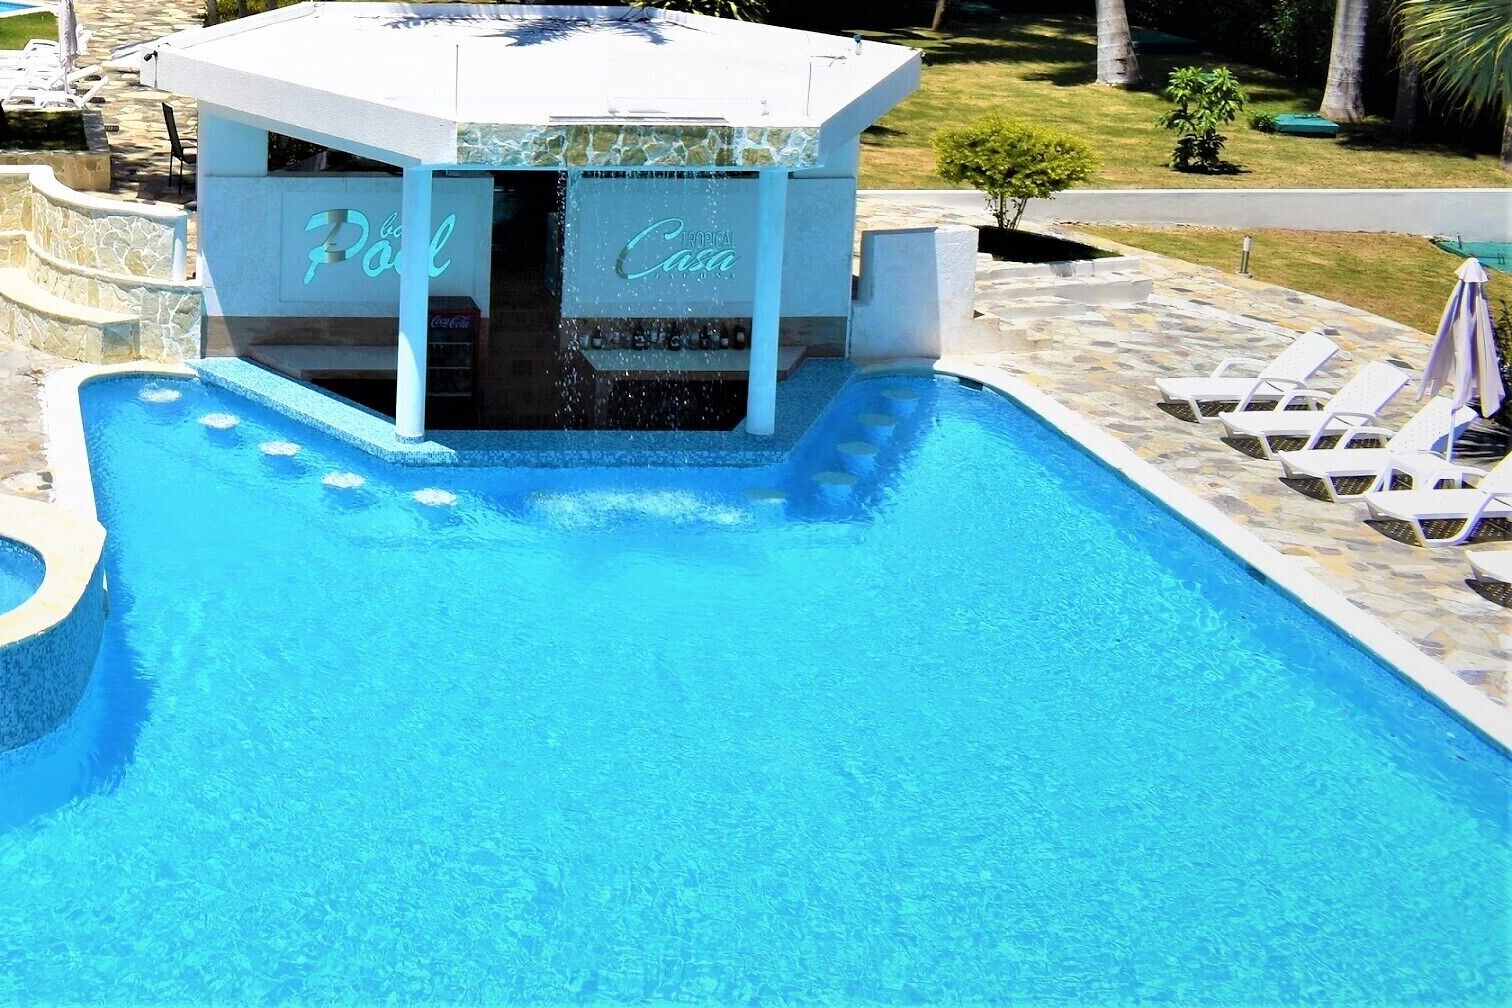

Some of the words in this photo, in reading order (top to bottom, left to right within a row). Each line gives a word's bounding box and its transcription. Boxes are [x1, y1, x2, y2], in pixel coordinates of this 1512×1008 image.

[304, 209, 456, 285] Pol
[615, 218, 741, 279] Casa
[682, 231, 736, 249] TROPICAL
